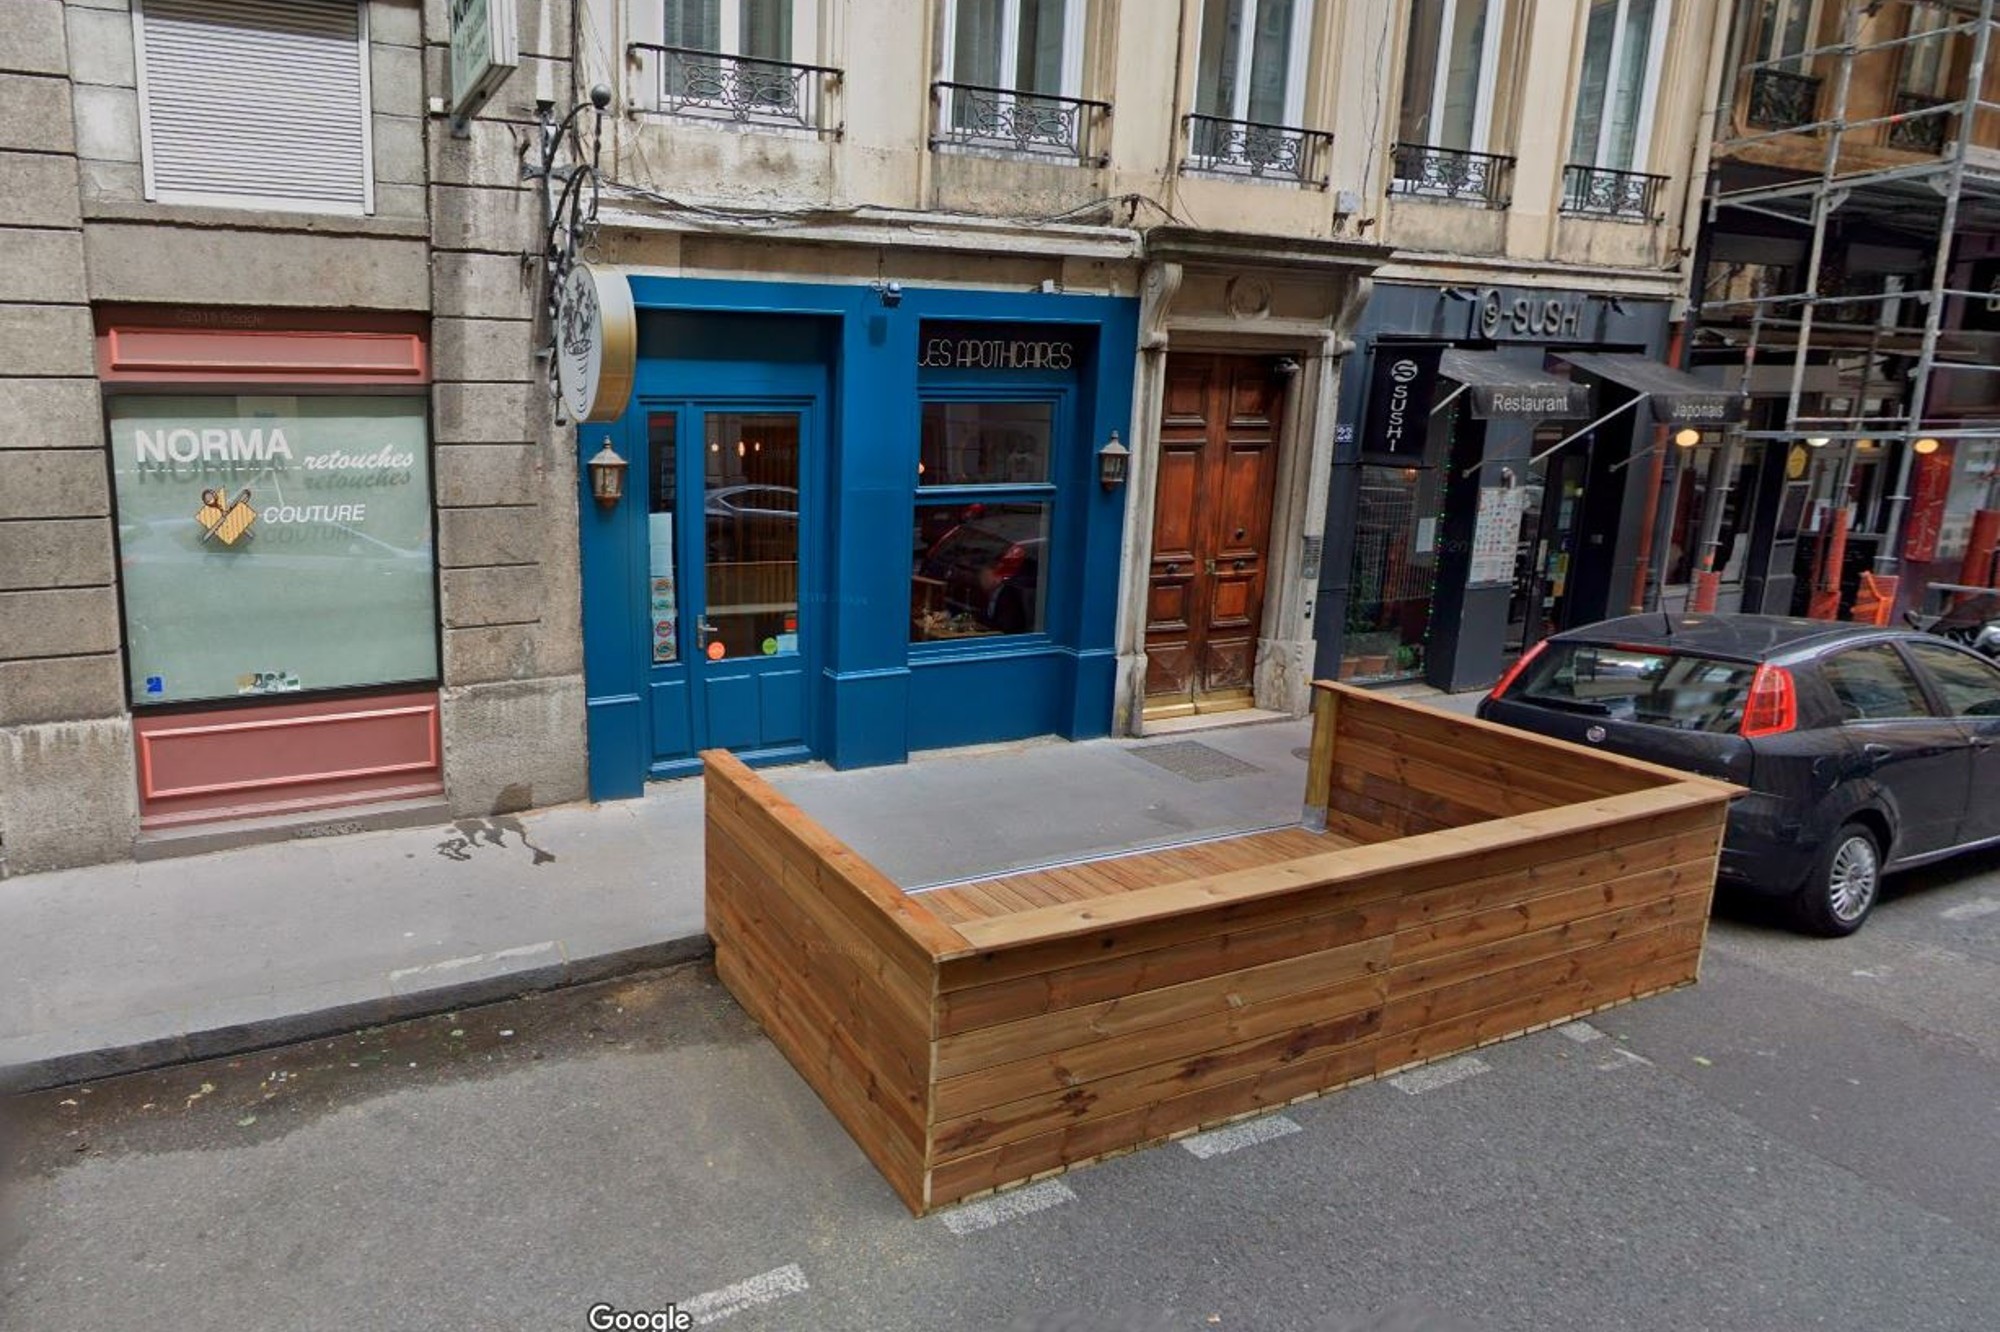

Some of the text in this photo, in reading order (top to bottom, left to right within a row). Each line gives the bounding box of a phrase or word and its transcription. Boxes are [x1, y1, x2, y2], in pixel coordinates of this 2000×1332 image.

[956, 339, 1073, 370] APOTHICAIRES
[1492, 393, 1568, 412] Restaurant
[1386, 385, 1408, 453] SUSHI
[134, 428, 293, 463] NORMA
[1337, 426, 1352, 440] 23
[302, 444, 414, 471] retouches
[263, 504, 366, 524] COUTURE
